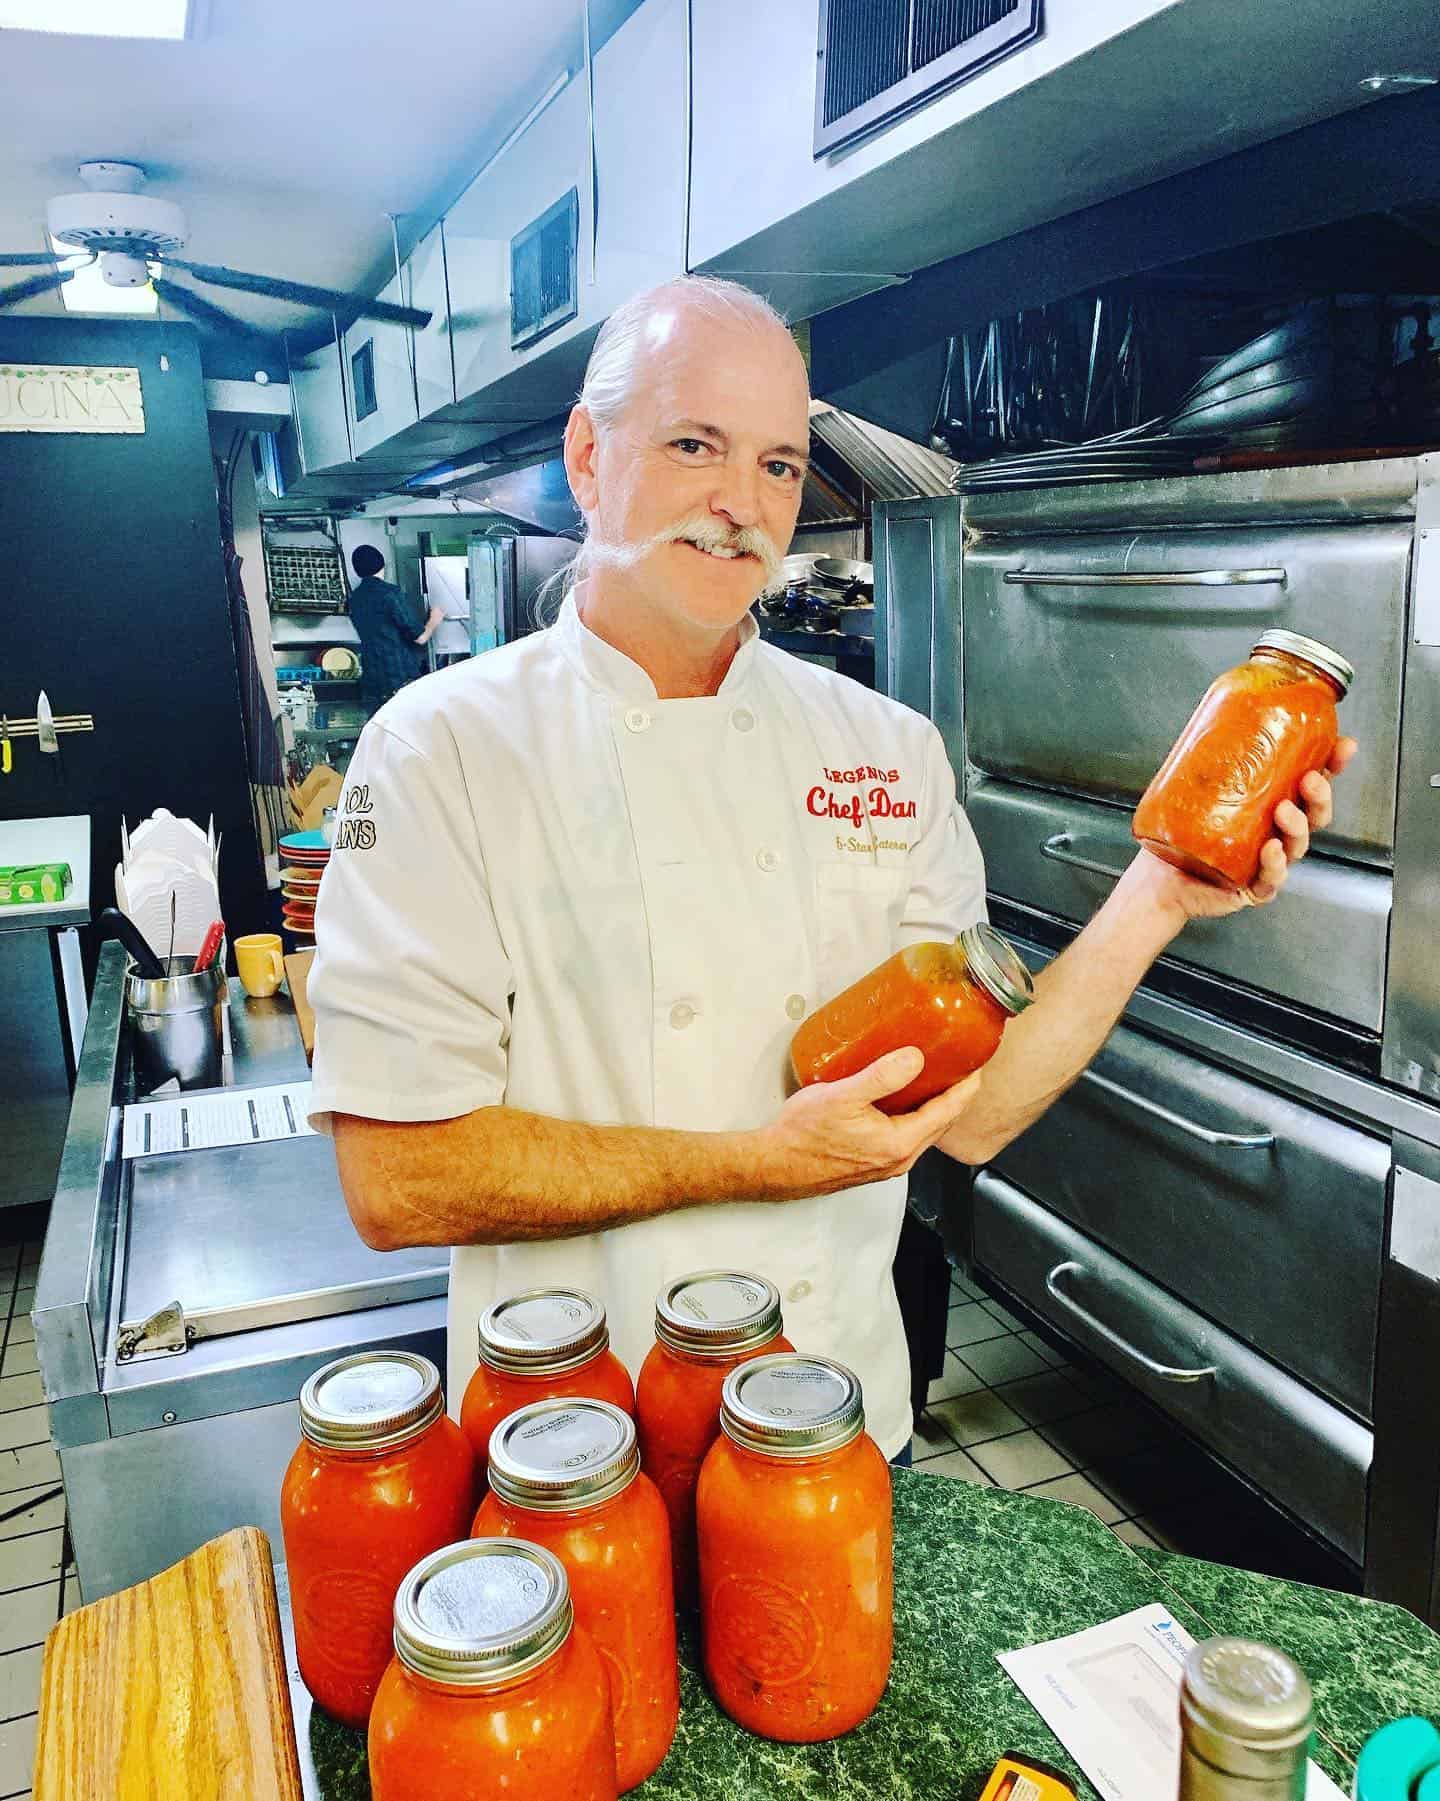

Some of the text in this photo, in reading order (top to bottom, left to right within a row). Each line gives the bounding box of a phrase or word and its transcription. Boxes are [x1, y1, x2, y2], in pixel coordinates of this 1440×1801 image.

[822, 766, 900, 784] LEGENDS
[806, 786, 917, 829] Chef Dan
[1161, 1631, 1189, 1657] PEOPL
